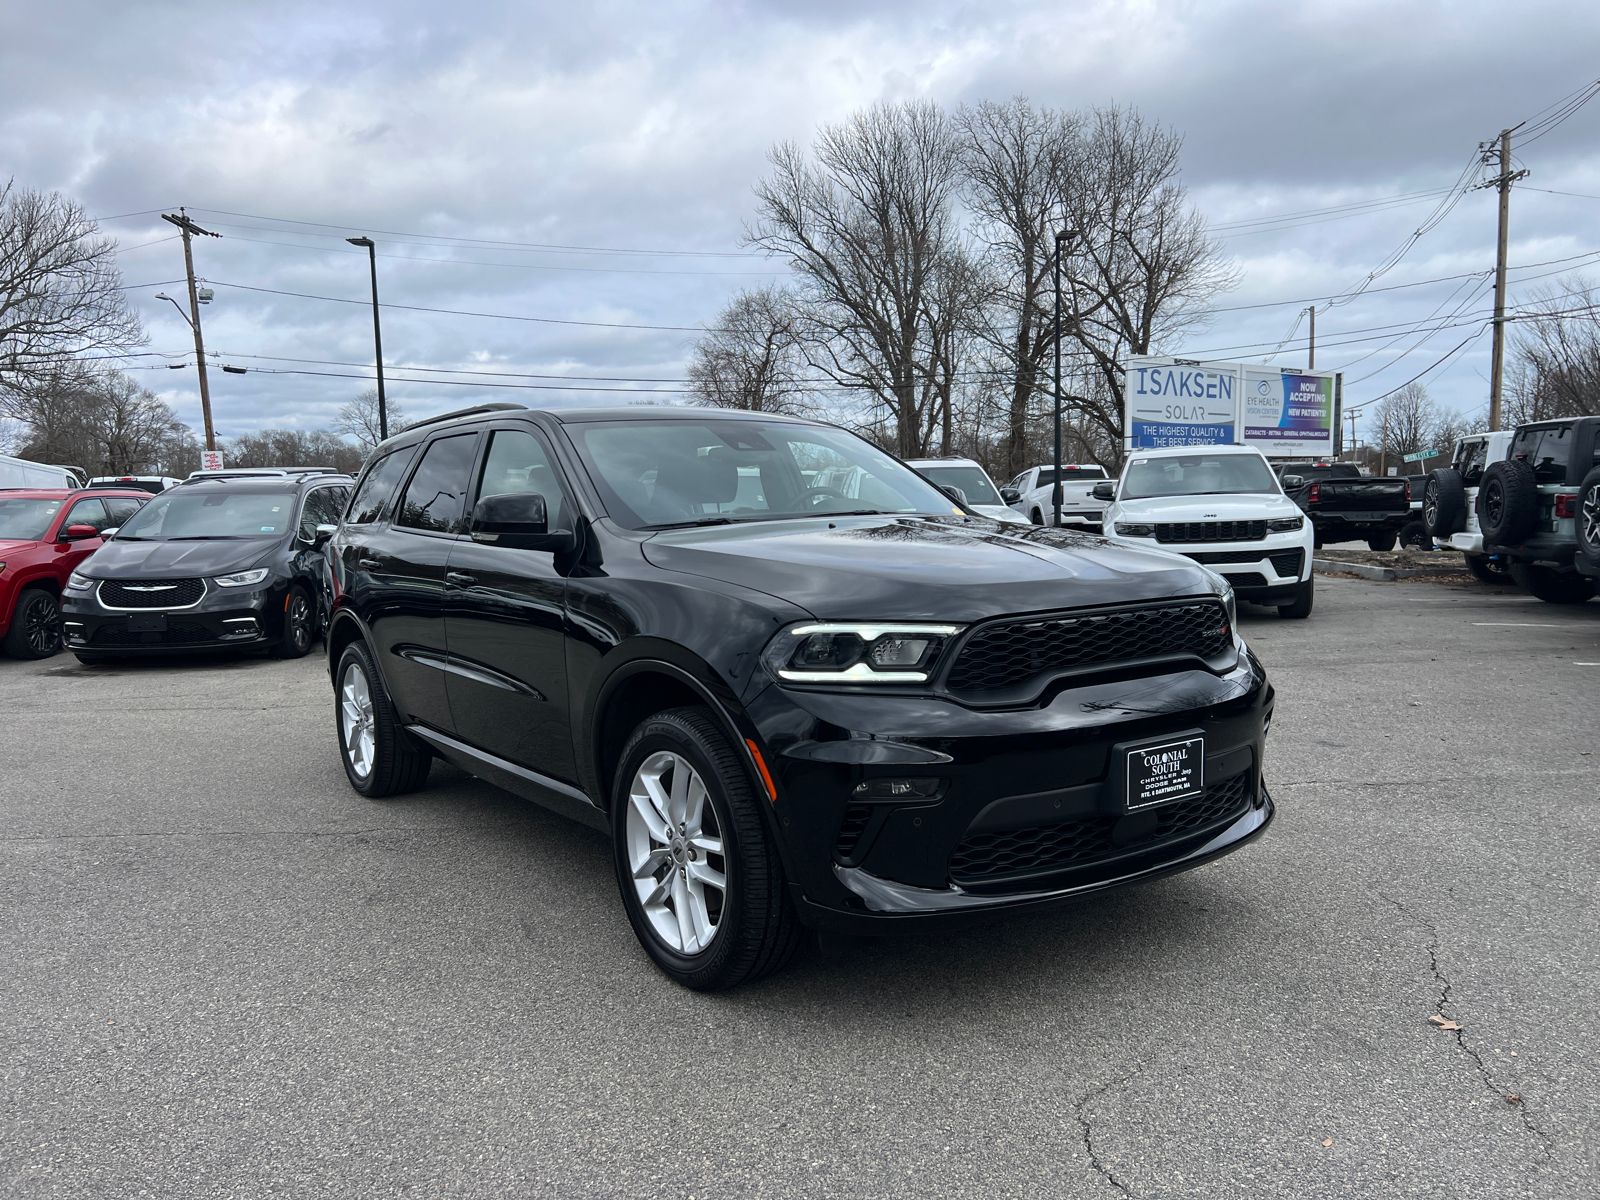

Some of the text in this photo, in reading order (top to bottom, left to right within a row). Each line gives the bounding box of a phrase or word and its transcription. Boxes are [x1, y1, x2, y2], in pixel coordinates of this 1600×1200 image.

[1136, 368, 1232, 399] ISAKSEN
[1300, 383, 1316, 392] NOW
[1248, 397, 1279, 406] EYE HEALTH
[1289, 392, 1326, 402] ACCEPTING
[1165, 405, 1205, 420] SOLAR
[1288, 408, 1326, 417] NEW PATIENTS!
[1143, 426, 1224, 437] THE HIGHEST QUALITY &
[1153, 437, 1216, 446] THE BEST SERVICE
[1144, 749, 1188, 766] COLONIAL
[1152, 761, 1180, 775] SOUTH
[1140, 773, 1177, 784] CHRYSLER
[1145, 780, 1168, 790] DODGE
